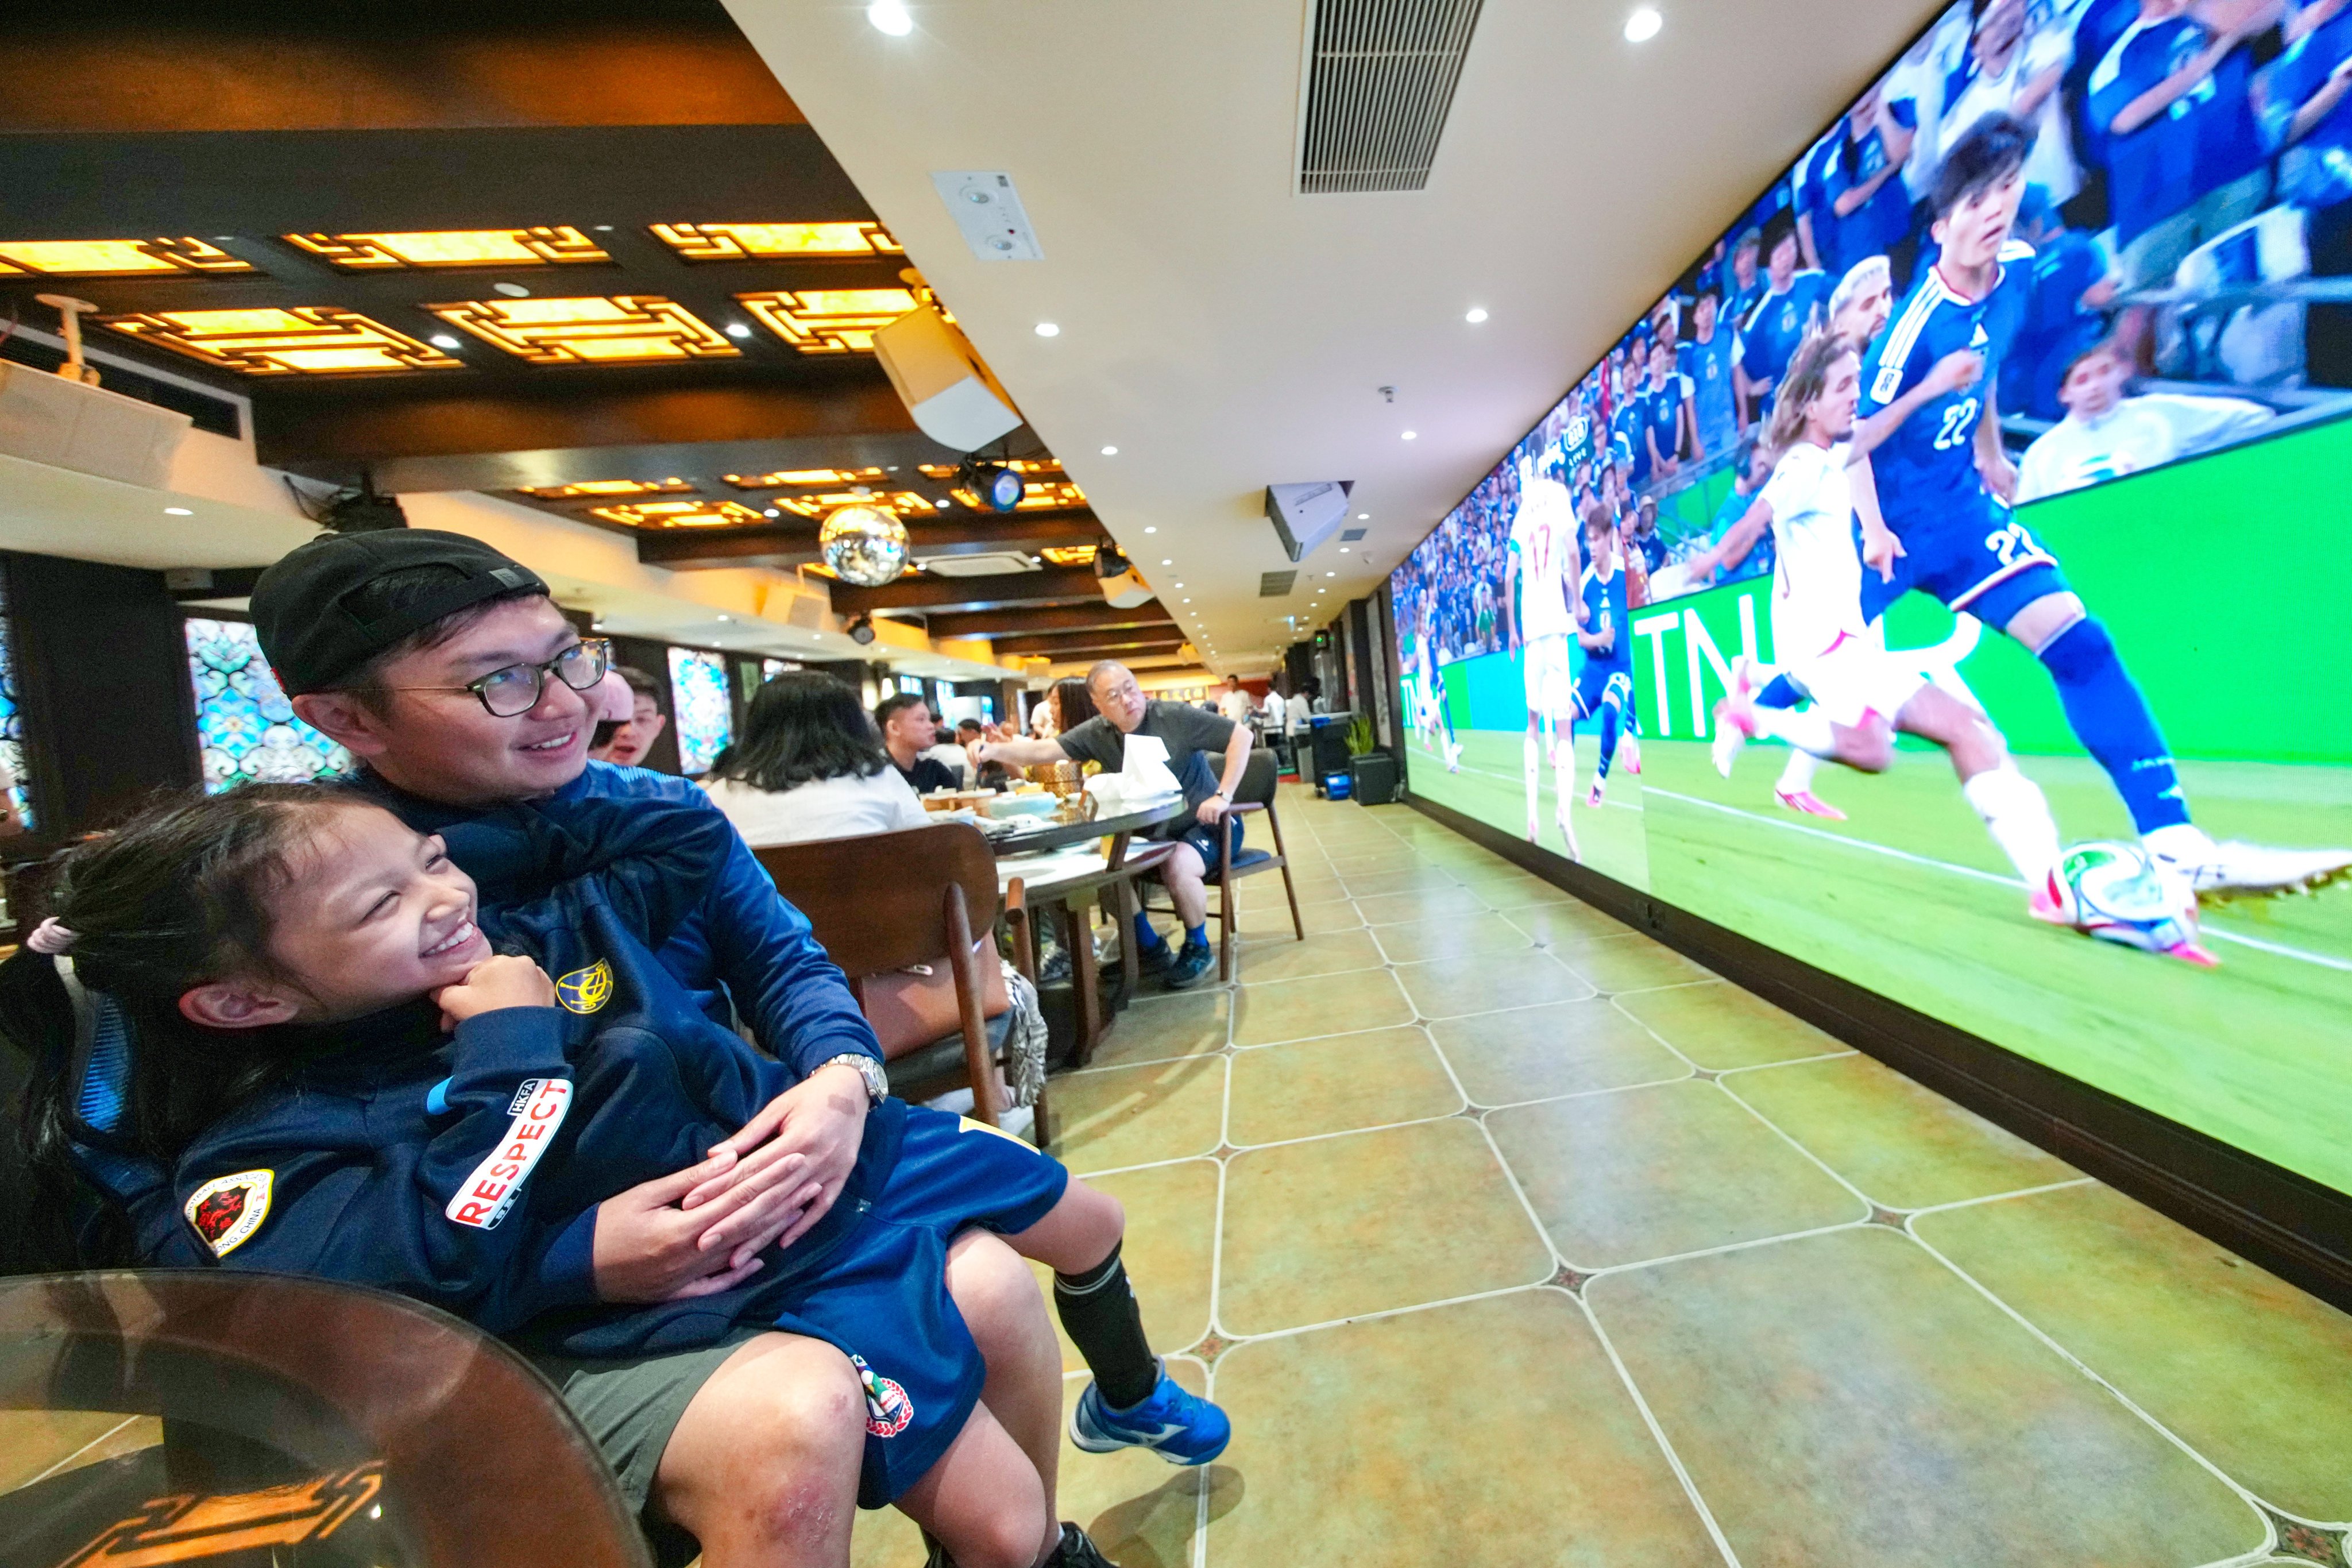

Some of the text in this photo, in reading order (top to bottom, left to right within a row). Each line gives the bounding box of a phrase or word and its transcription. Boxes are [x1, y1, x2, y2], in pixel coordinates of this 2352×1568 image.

[1933, 397, 1978, 450] 22
[1528, 523, 1550, 582] 17
[1633, 593, 1754, 737] TN
[512, 1082, 536, 1113] HKFA
[455, 1080, 567, 1225] RESPECT
[186, 1183, 215, 1219] OOTBALL
[240, 1208, 262, 1234] CHINA
